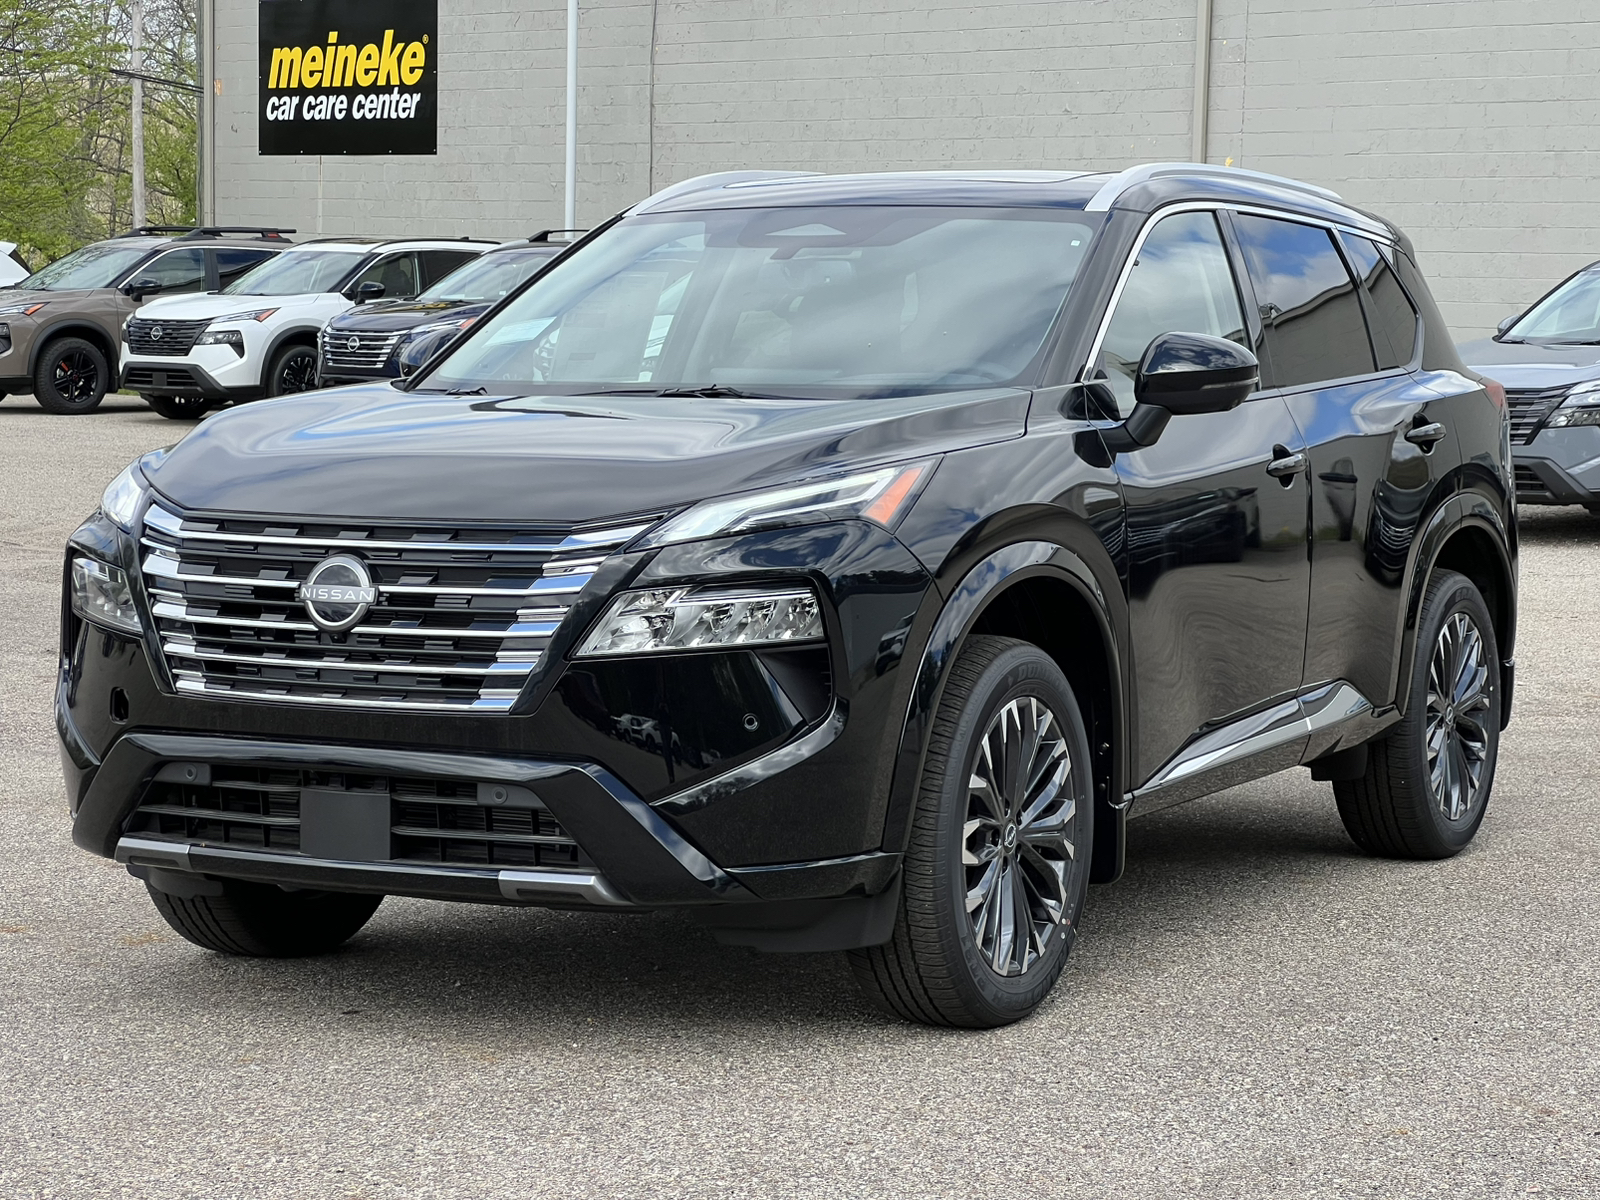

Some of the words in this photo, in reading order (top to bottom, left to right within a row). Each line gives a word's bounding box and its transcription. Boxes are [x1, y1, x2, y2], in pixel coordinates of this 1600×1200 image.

[268, 29, 426, 89] meineke
[266, 95, 300, 121] car
[302, 94, 348, 121] care
[352, 86, 421, 120] center
[301, 587, 373, 601] NISSAN
